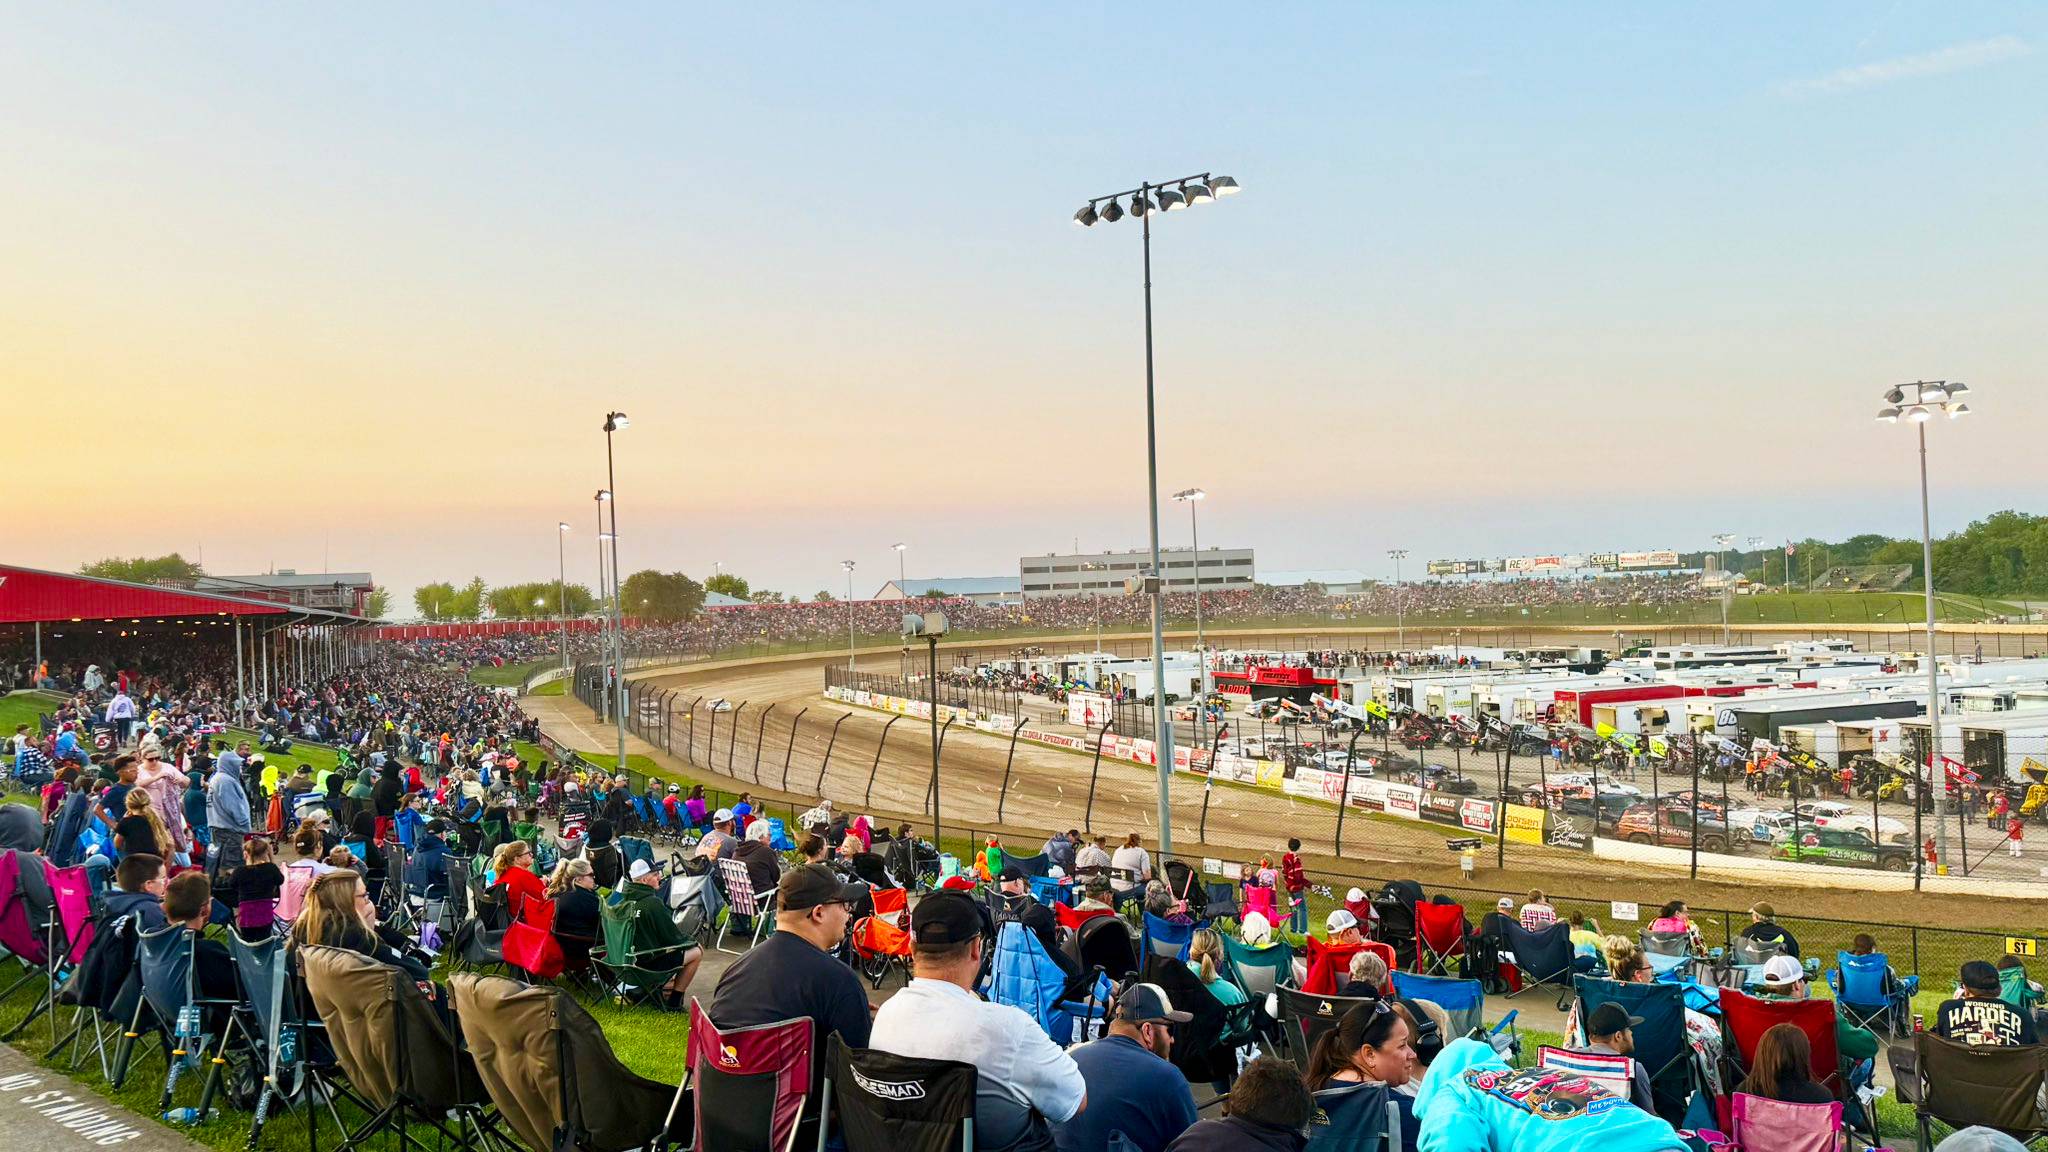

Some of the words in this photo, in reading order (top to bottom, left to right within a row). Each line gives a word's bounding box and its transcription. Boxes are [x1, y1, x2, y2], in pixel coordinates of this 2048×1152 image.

[1218, 683, 1251, 695] ELDORA
[1022, 729, 1043, 741] ELDORA
[1043, 733, 1074, 747] SPEEDWAY
[1946, 761, 1960, 776] 45
[1387, 789, 1413, 803] LINCOLN
[1432, 796, 1457, 808] AMKUS
[1391, 800, 1416, 811] ELECTRIC
[1468, 817, 1487, 828] PIZZA
[1547, 830, 1585, 849] Ballroom
[2013, 941, 2028, 954] ST
[1964, 1000, 2006, 1010] WORKING
[1948, 1006, 2022, 1035] HARDER
[20, 1089, 142, 1146] STANDING
